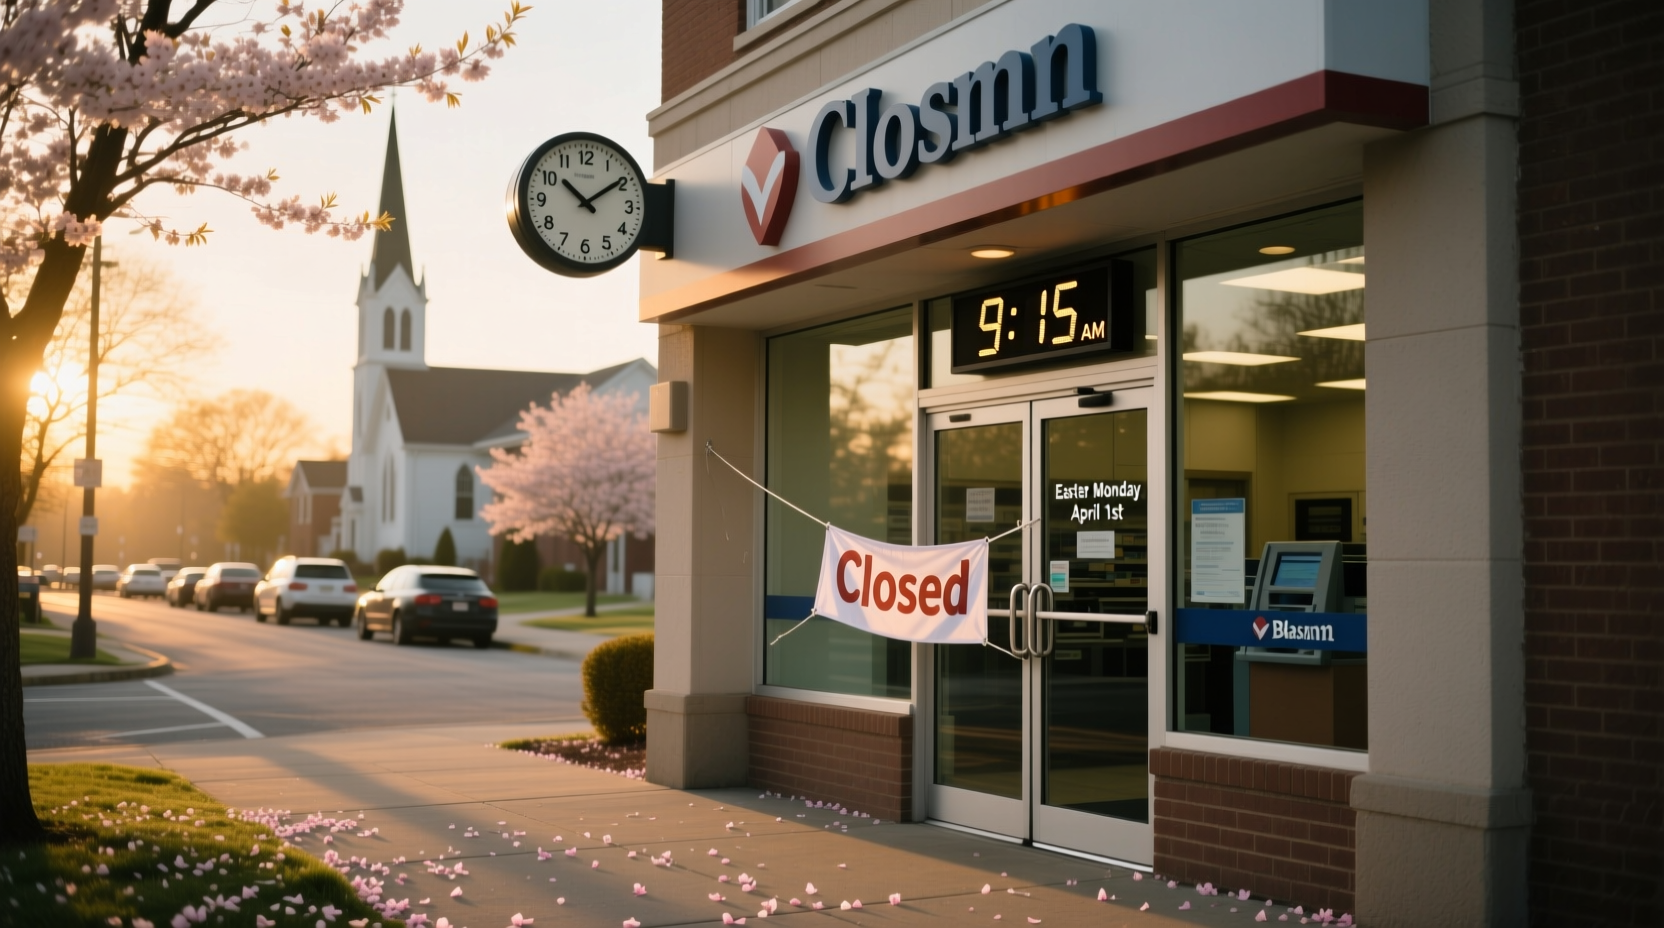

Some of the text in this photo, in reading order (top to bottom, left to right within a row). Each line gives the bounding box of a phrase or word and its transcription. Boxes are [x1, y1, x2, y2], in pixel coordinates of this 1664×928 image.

[805, 22, 1103, 204] Closmn
[559, 153, 570, 168] 11
[578, 150, 594, 166] 12
[605, 159, 610, 172] 1
[542, 170, 557, 186] 10
[618, 176, 628, 191] 2
[536, 192, 547, 207] 9
[624, 200, 634, 214] 3
[543, 215, 554, 230] 8
[617, 221, 628, 236] 4
[559, 232, 569, 246] 7
[580, 238, 590, 254] 6
[601, 235, 612, 250] 5
[978, 280, 1105, 357] 9:15 AM
[1093, 480, 1141, 502] Monday
[1070, 503, 1124, 525] April 1st
[836, 549, 970, 616] Closed
